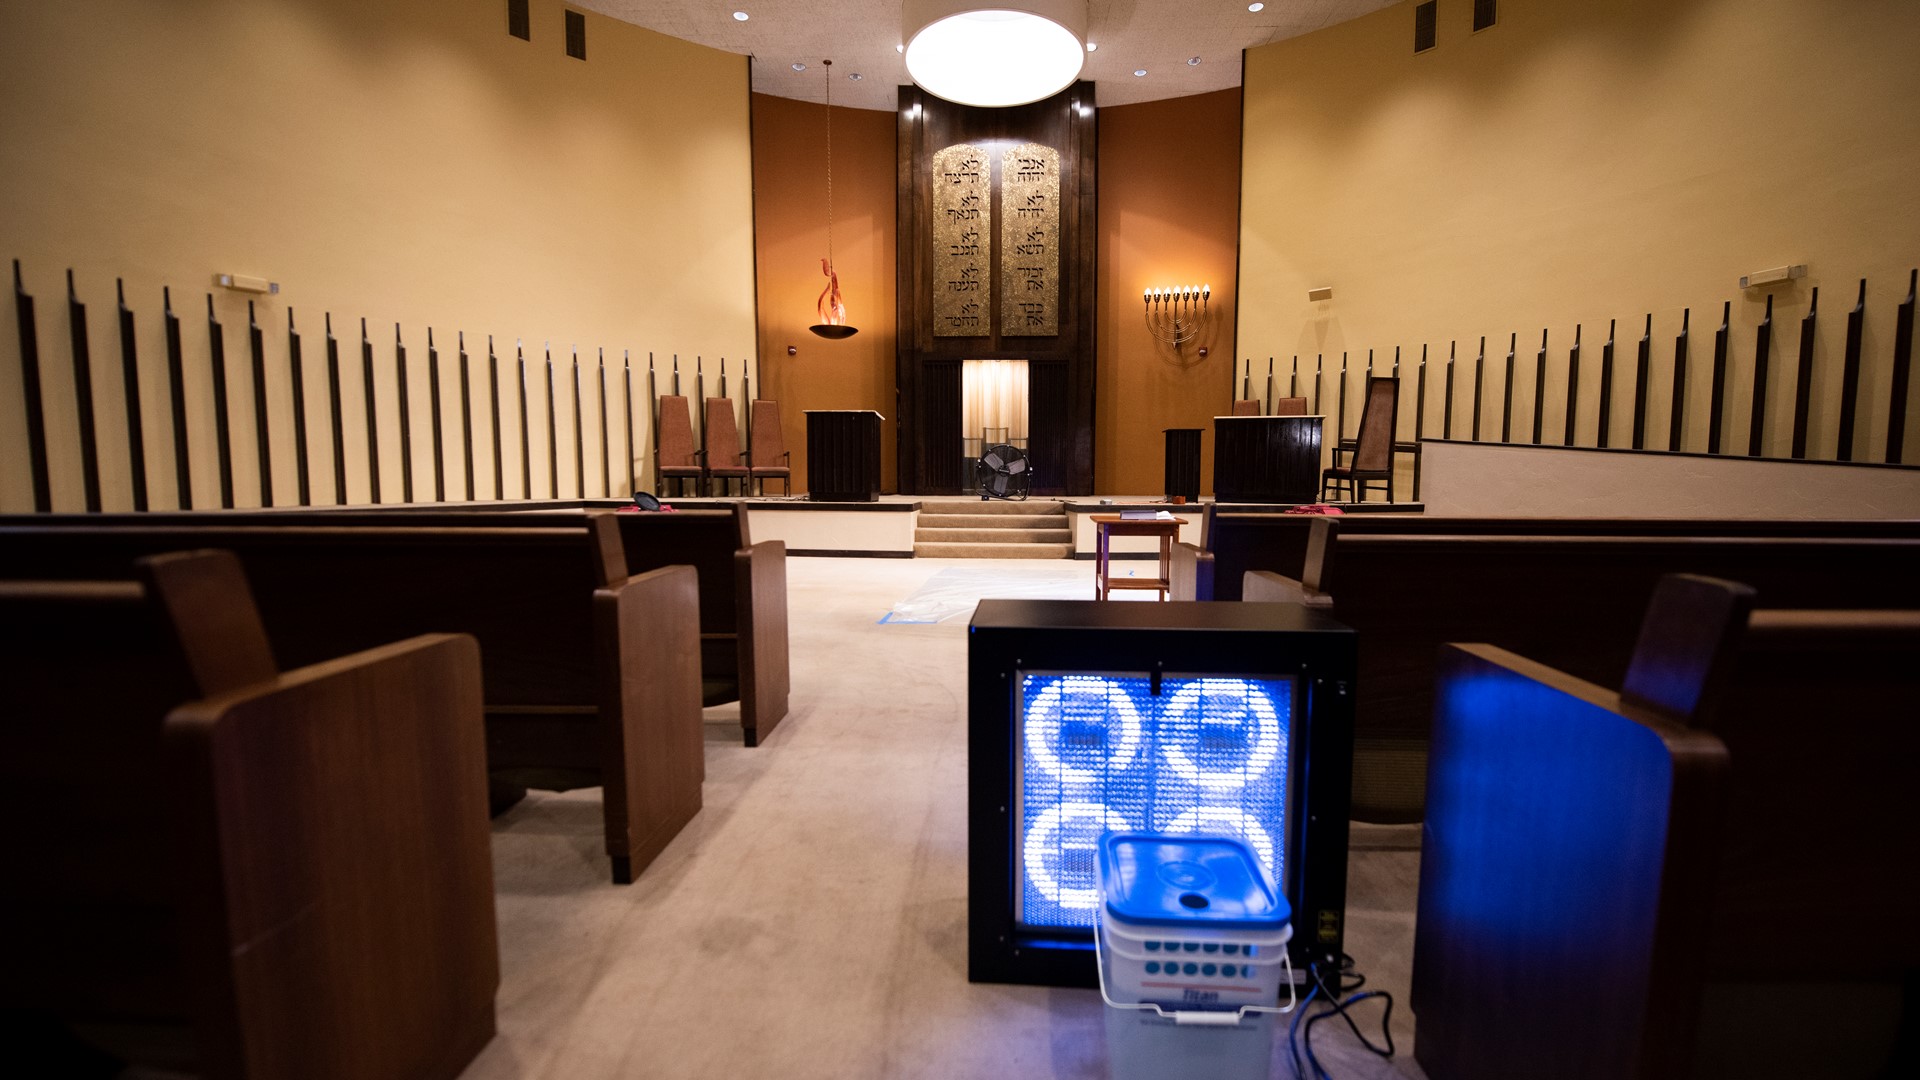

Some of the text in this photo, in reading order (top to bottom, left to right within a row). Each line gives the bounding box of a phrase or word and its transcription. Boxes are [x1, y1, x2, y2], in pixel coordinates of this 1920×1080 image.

[962, 154, 979, 170] לא
[1018, 159, 1045, 170] אנכי
[1018, 172, 1045, 182] יהוה
[962, 190, 979, 207] לא
[1027, 190, 1045, 206] לא
[947, 209, 979, 225] תנאף
[1018, 208, 1045, 218] יהיה
[961, 226, 979, 242] לא
[1027, 225, 1045, 242] לא
[950, 245, 979, 256] תגנב
[1016, 244, 1045, 255] תשא
[961, 262, 979, 279] לא
[1017, 267, 1044, 278] זכור
[948, 281, 979, 292] תענה
[1026, 280, 1044, 291] את
[961, 298, 979, 315] לא
[1018, 303, 1044, 314] כבד
[1026, 315, 1044, 326] את
[1183, 988, 1220, 1001] Titan
